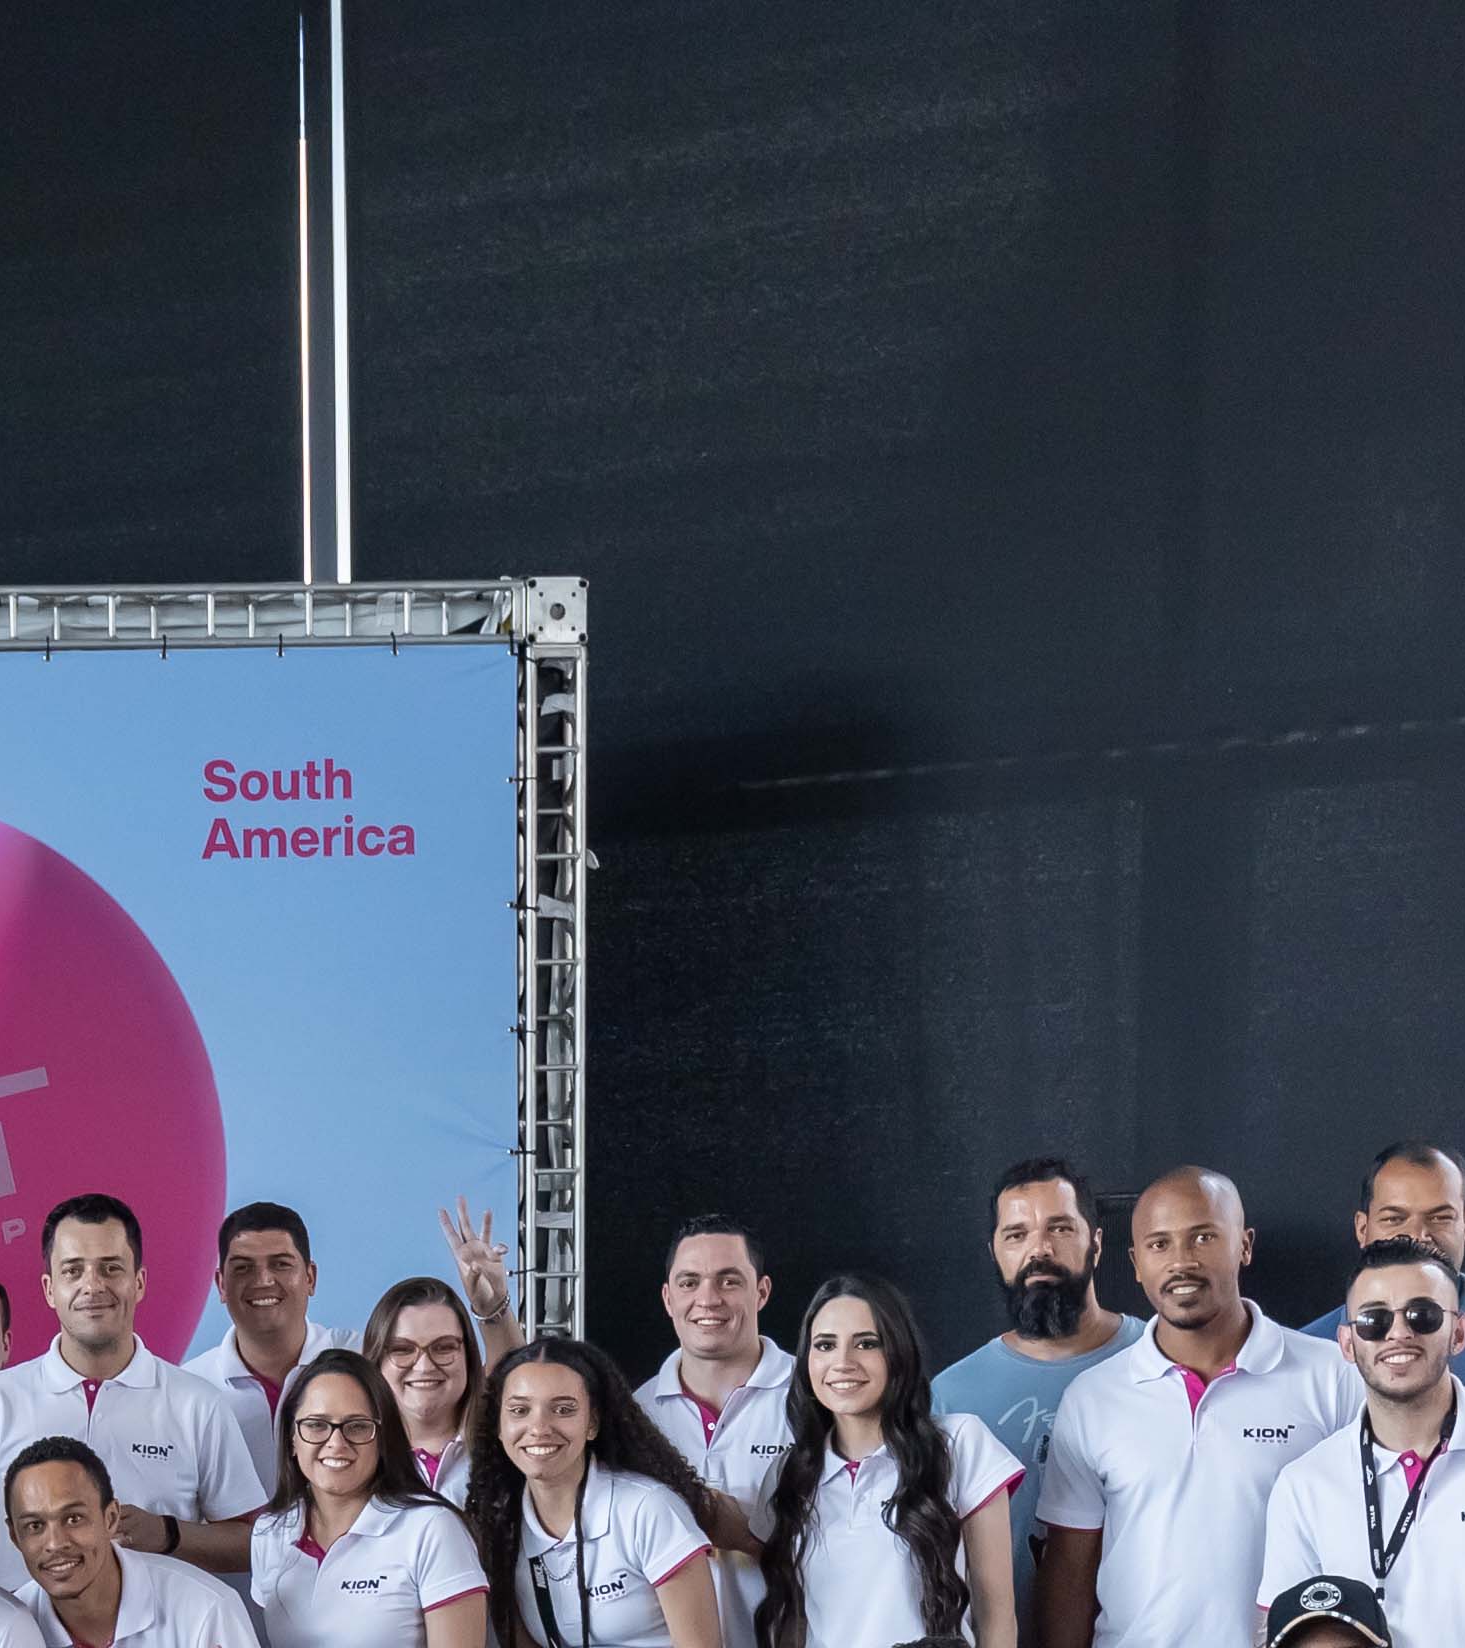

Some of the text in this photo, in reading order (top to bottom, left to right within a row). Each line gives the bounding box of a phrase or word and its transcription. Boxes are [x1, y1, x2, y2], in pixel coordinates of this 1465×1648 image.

[203, 758, 353, 802] South
[202, 815, 415, 859] America
[1243, 1428, 1288, 1439] KION
[132, 1444, 169, 1457] KION
[341, 1579, 379, 1590] KION
[586, 1580, 625, 1598] KION
